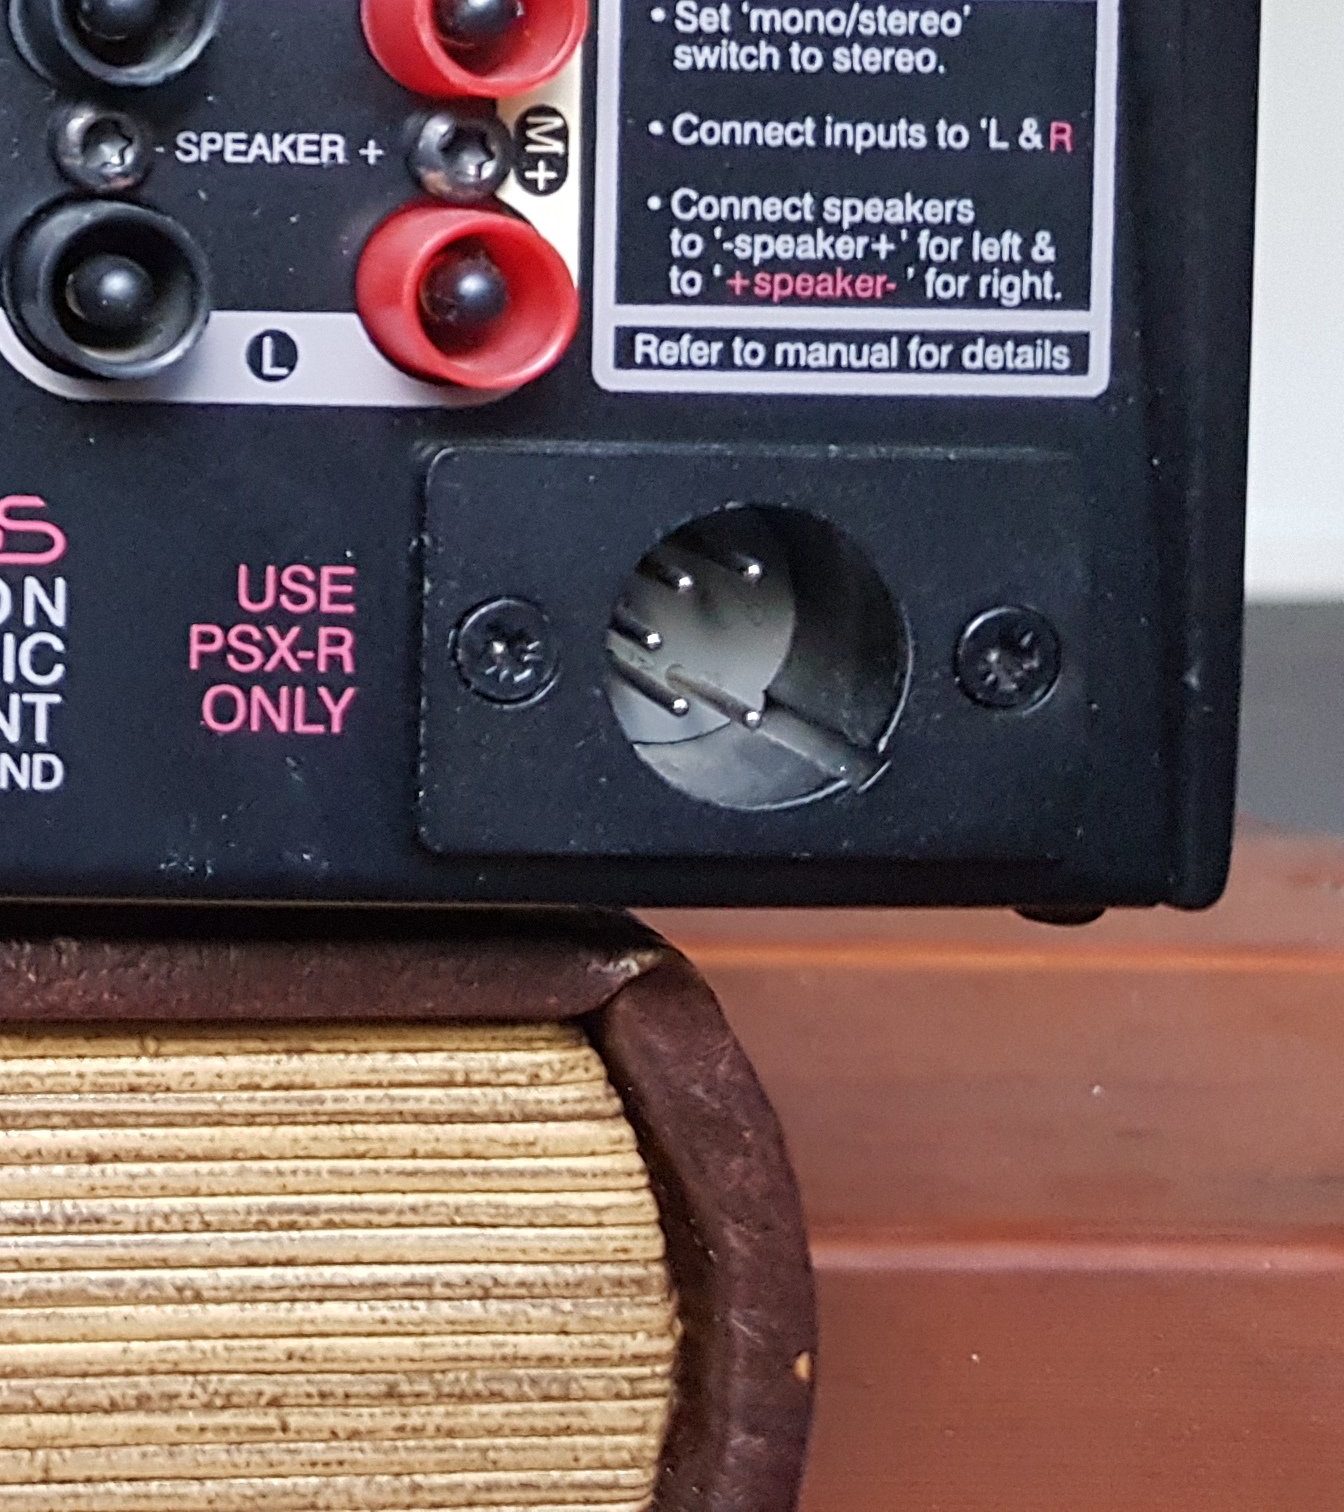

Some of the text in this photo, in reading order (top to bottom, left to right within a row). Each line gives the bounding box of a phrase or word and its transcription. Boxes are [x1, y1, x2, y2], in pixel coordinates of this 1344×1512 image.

[675, 3, 731, 32] Set
[674, 43, 945, 74] switch to stereo.
[175, 132, 345, 164] SPEAKER
[672, 114, 814, 145] Connect
[824, 118, 926, 153] inputs
[935, 121, 968, 149] to
[670, 188, 975, 227] Connect speakers
[670, 230, 703, 256] to
[918, 231, 962, 260] for
[972, 232, 1021, 261] left
[669, 269, 702, 295] to
[925, 270, 968, 298] for
[979, 271, 1061, 305] right.
[635, 335, 1070, 370] Refer to manual for details
[236, 564, 356, 613] USE
[189, 624, 354, 673] PSX-R
[202, 684, 357, 734] ONLY
